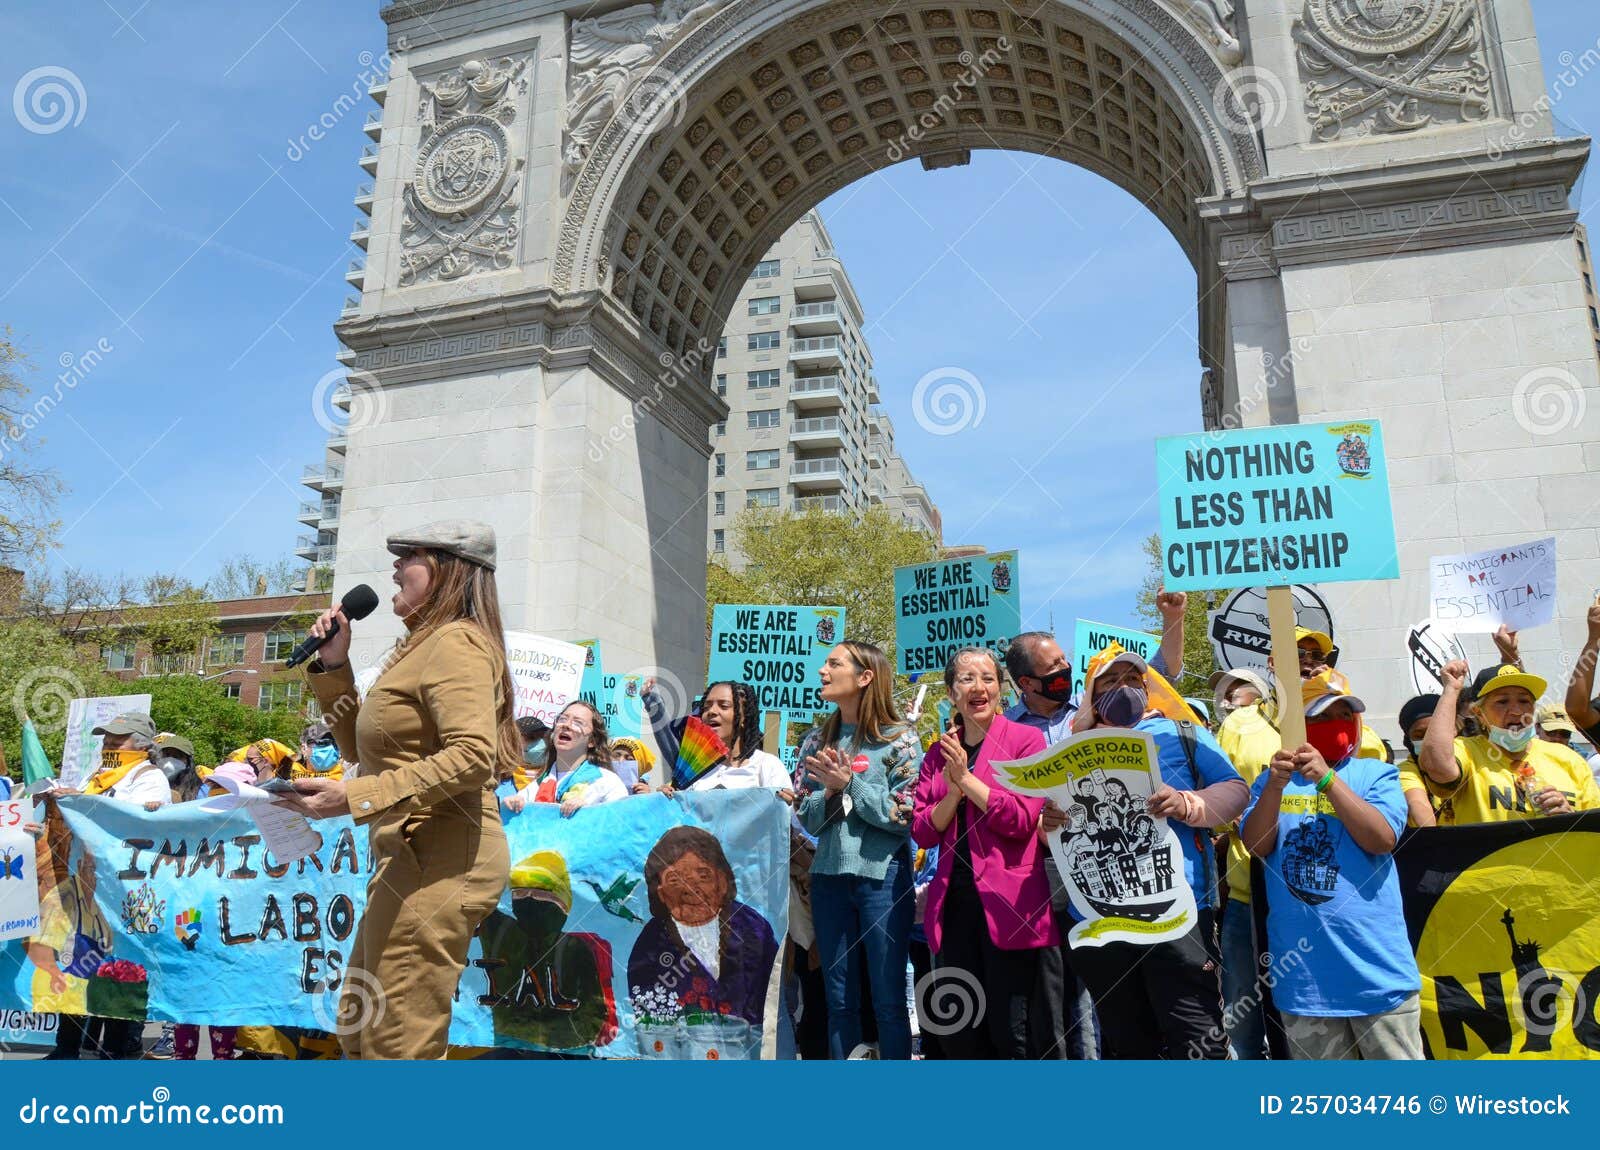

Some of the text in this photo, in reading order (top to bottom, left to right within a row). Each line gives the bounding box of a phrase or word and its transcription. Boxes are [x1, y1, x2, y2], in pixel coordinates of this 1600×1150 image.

[1185, 440, 1314, 483] NOTHING
[1175, 485, 1333, 530] LESS THAN
[1167, 532, 1349, 578] CITIZENSHIP
[1437, 544, 1546, 577] IMMIGRANTS
[914, 562, 973, 590] WE ARE
[1468, 571, 1500, 588] ARE
[901, 585, 990, 617] ESSENTIAL!
[1435, 582, 1551, 619] ESSENTIAL
[736, 609, 798, 632] WE ARE
[927, 614, 986, 643] SOMOS
[718, 632, 812, 656] ESSENTIAL!
[742, 660, 805, 683] SOMOS
[1022, 742, 1143, 782] MAKE THE ROAD
[1078, 755, 1143, 772] NEW YORK
[1281, 798, 1301, 806] AKE
[218, 892, 354, 945] LABO
[0, 1009, 57, 1031] IGNID
